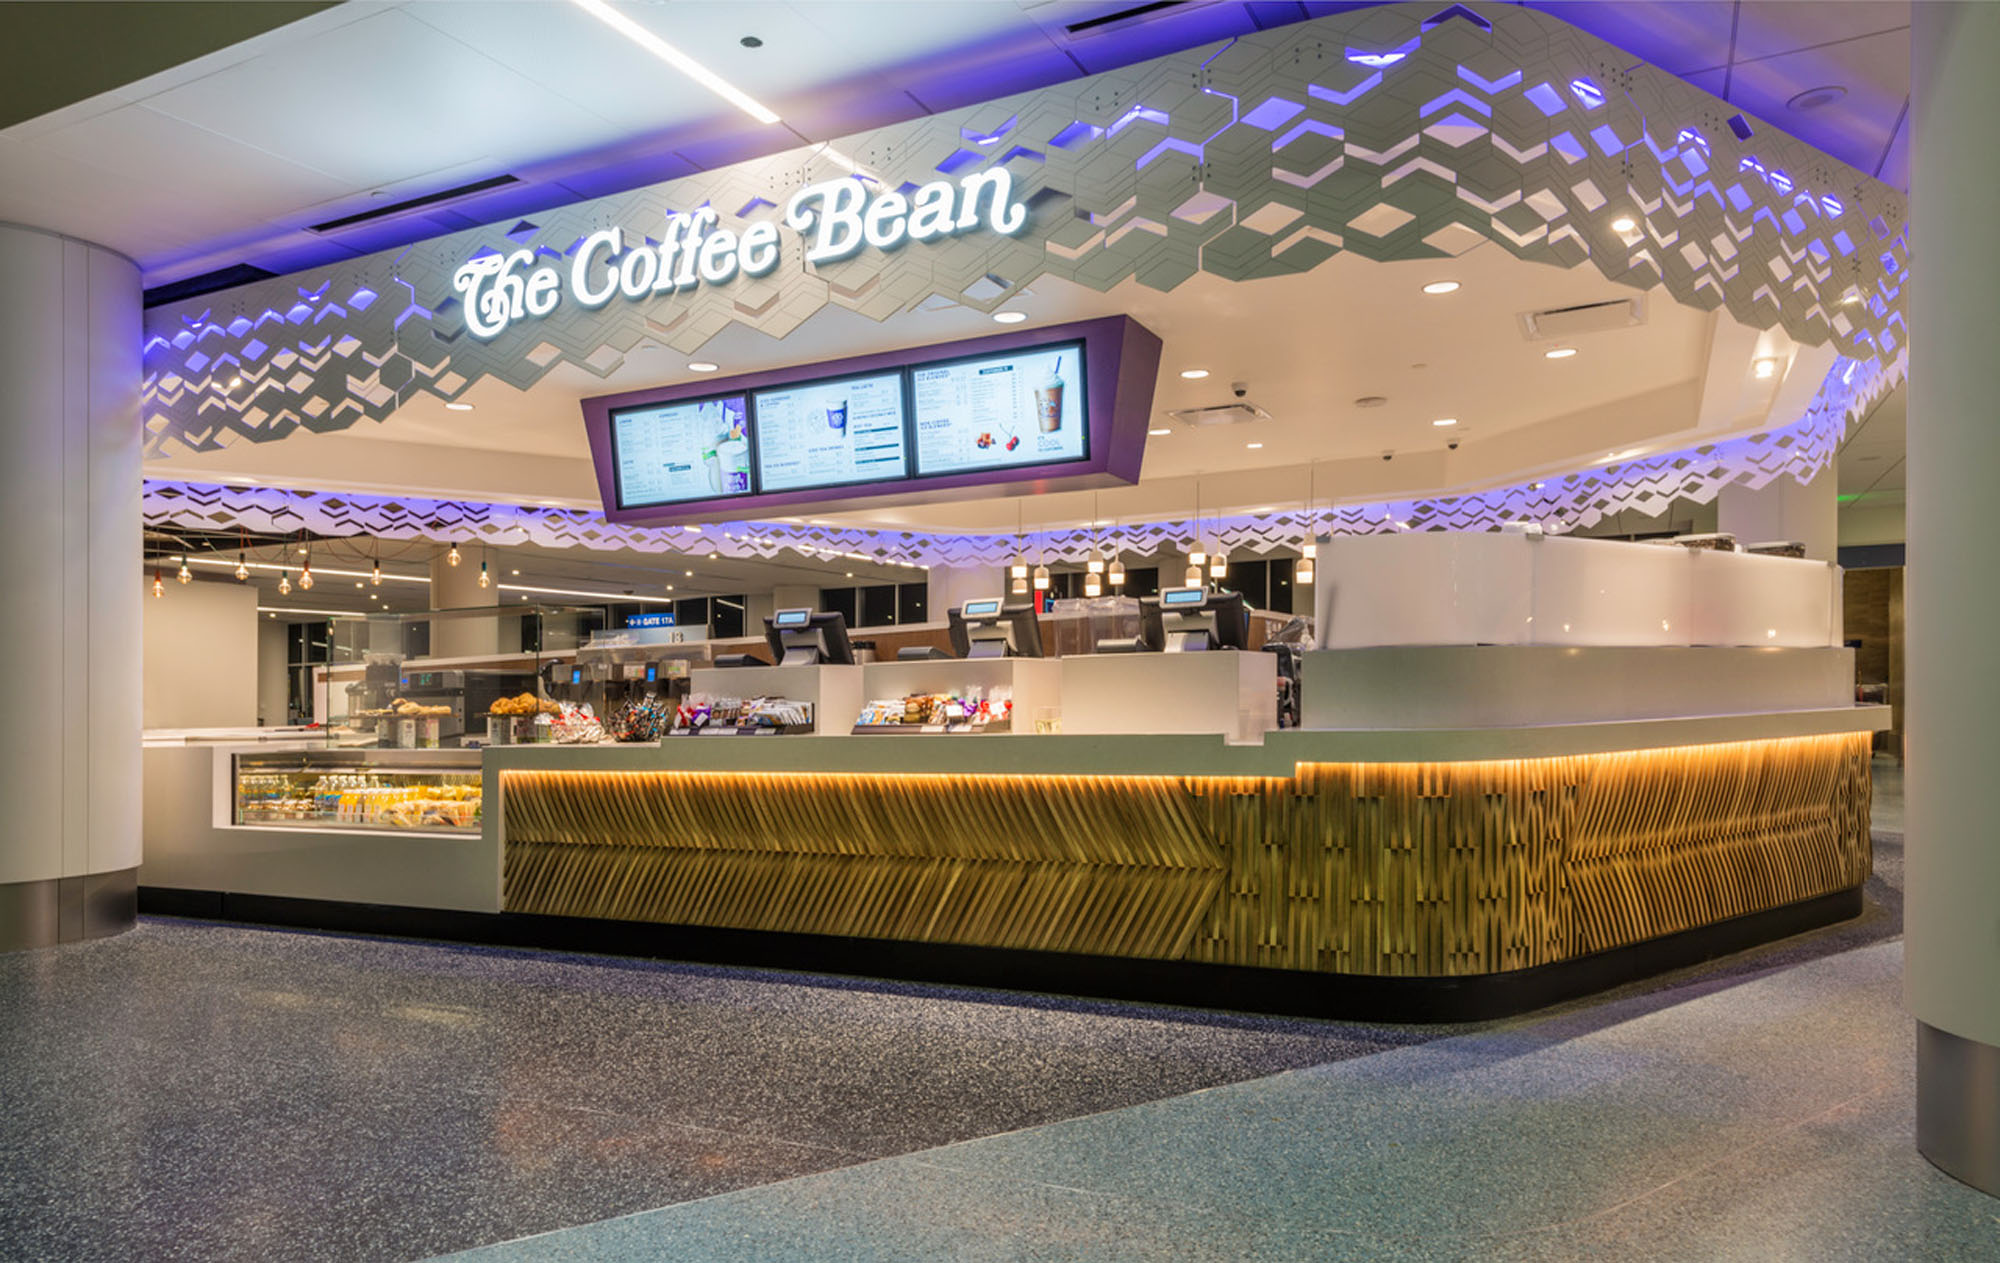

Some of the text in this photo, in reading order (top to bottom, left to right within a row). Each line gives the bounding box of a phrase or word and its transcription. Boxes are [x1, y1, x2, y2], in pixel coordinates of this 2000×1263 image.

[453, 166, 1027, 338] The Coffee Bean
[643, 617, 660, 626] GATE
